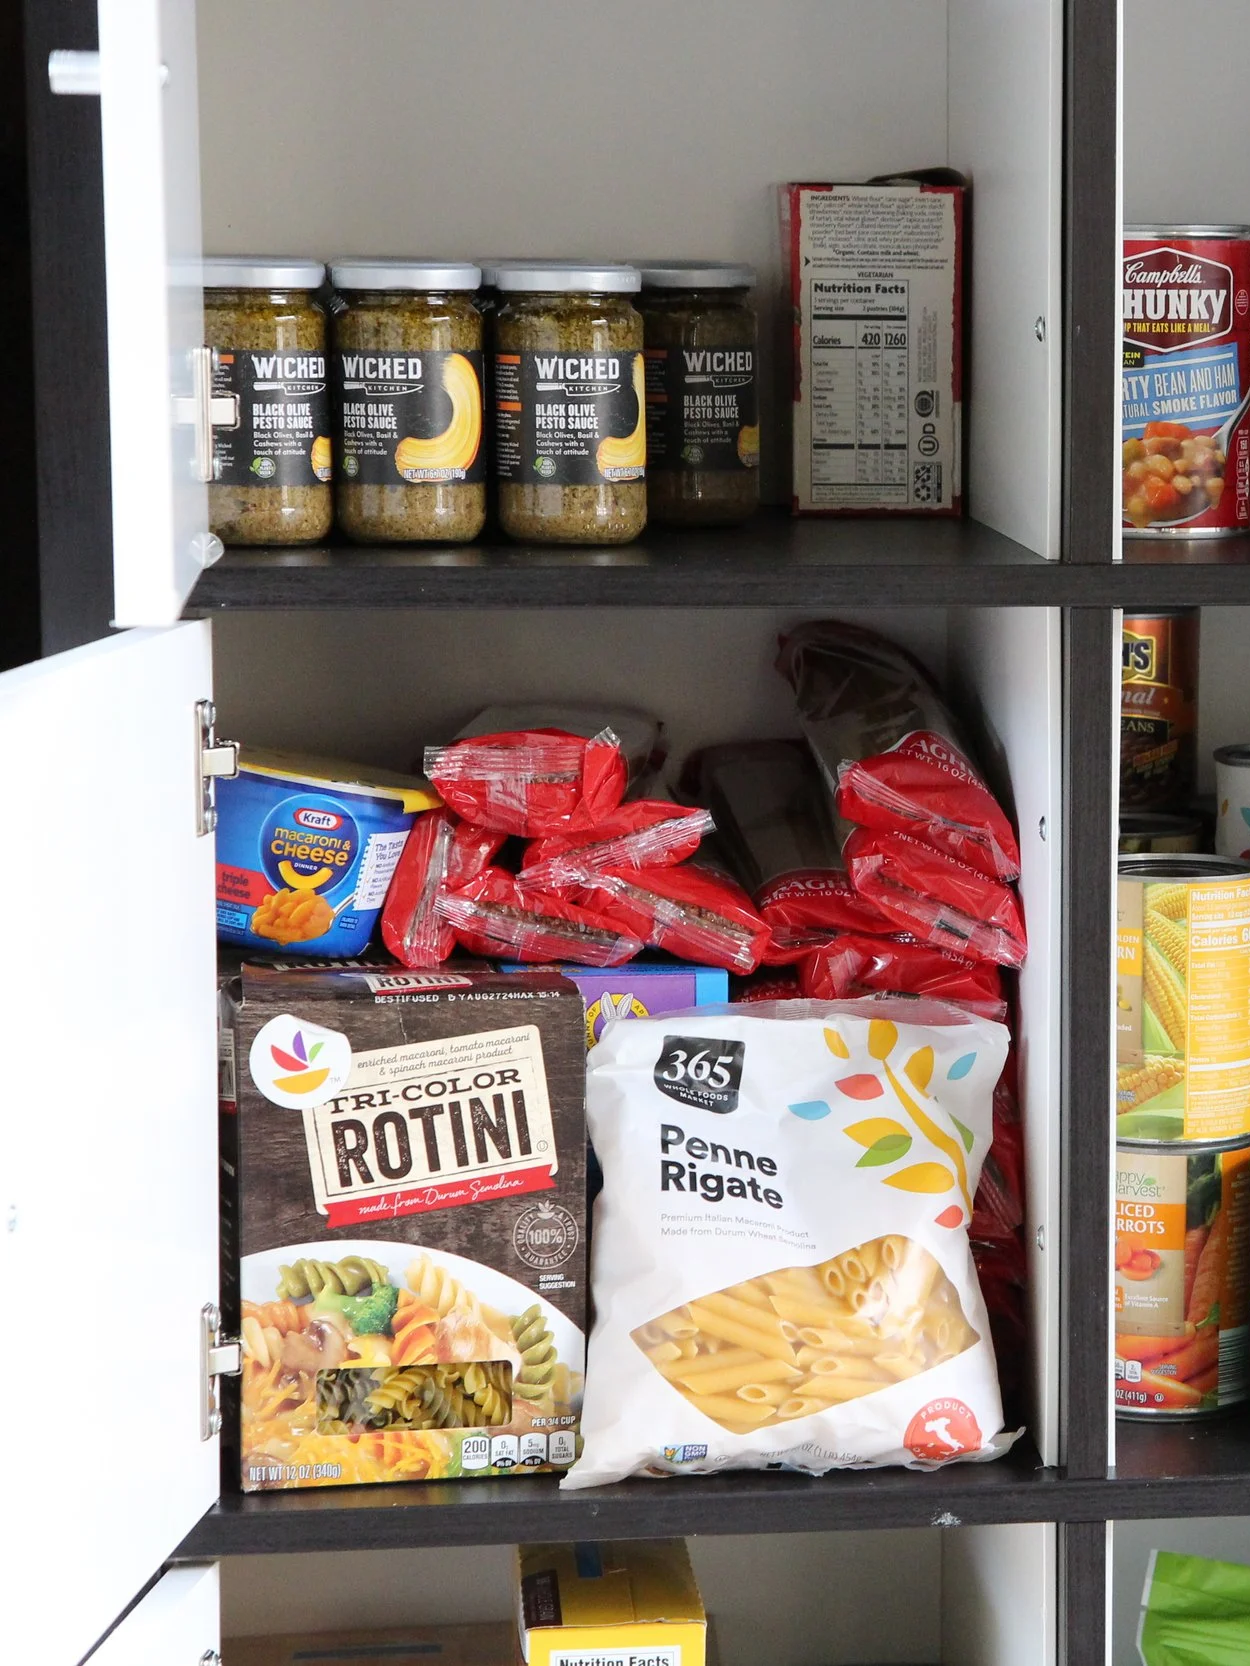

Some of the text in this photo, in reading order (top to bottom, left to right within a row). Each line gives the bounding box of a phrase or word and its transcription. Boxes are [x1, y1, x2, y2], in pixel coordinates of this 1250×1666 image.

[1125, 262, 1202, 287] Campbell's
[814, 283, 905, 294] Nutrition Facts
[1123, 290, 1227, 324] HUNKY
[1134, 323, 1210, 332] THAT EATS LIKE A MEAL
[813, 333, 906, 345] Calories 420 1260
[251, 354, 325, 378] WICKED
[342, 355, 422, 379] WICKED
[534, 355, 620, 380] WICKED
[683, 350, 752, 372] WICKED
[1154, 363, 1235, 397] BEAN AND HAM
[253, 404, 311, 416] BLACK OLIVE
[535, 404, 595, 416] BLACK OLIVE
[1152, 390, 1237, 415] SMOKE FLAVOR
[253, 416, 313, 429] PESTO SAUCE
[536, 417, 598, 429] PESTO SAUCE
[303, 813, 331, 826] Kraft
[274, 827, 351, 851] macaroni &
[294, 862, 318, 871] DINNER
[222, 871, 249, 887] triple
[1192, 891, 1234, 901] Nutrition
[1192, 935, 1238, 946] Calories
[379, 976, 461, 987] ROTINI
[358, 1034, 530, 1069] enriched macaroni, tomato macaroni
[379, 1046, 513, 1078] & spinach macaroni product
[662, 1049, 734, 1089] 365
[325, 1068, 521, 1115] TRI-COLOR
[664, 1083, 728, 1102] WHOLE FOODS
[679, 1091, 715, 1107] MARKET
[331, 1089, 532, 1188] ROTINI
[660, 1123, 778, 1177] Penne
[660, 1160, 783, 1210] Rigate
[358, 1175, 524, 1217] made from Durum Semolina
[1117, 1219, 1166, 1234] RROTS
[529, 1228, 562, 1245] 100%
[539, 1281, 576, 1290] SUGGESTION
[1125, 1391, 1147, 1402] (411g)
[921, 1401, 971, 1420] PRODUCT
[531, 1416, 575, 1427] PER 3/4 CUP
[464, 1440, 487, 1453] 200
[250, 1463, 342, 1481] NET WT 12 OZ (340g)
